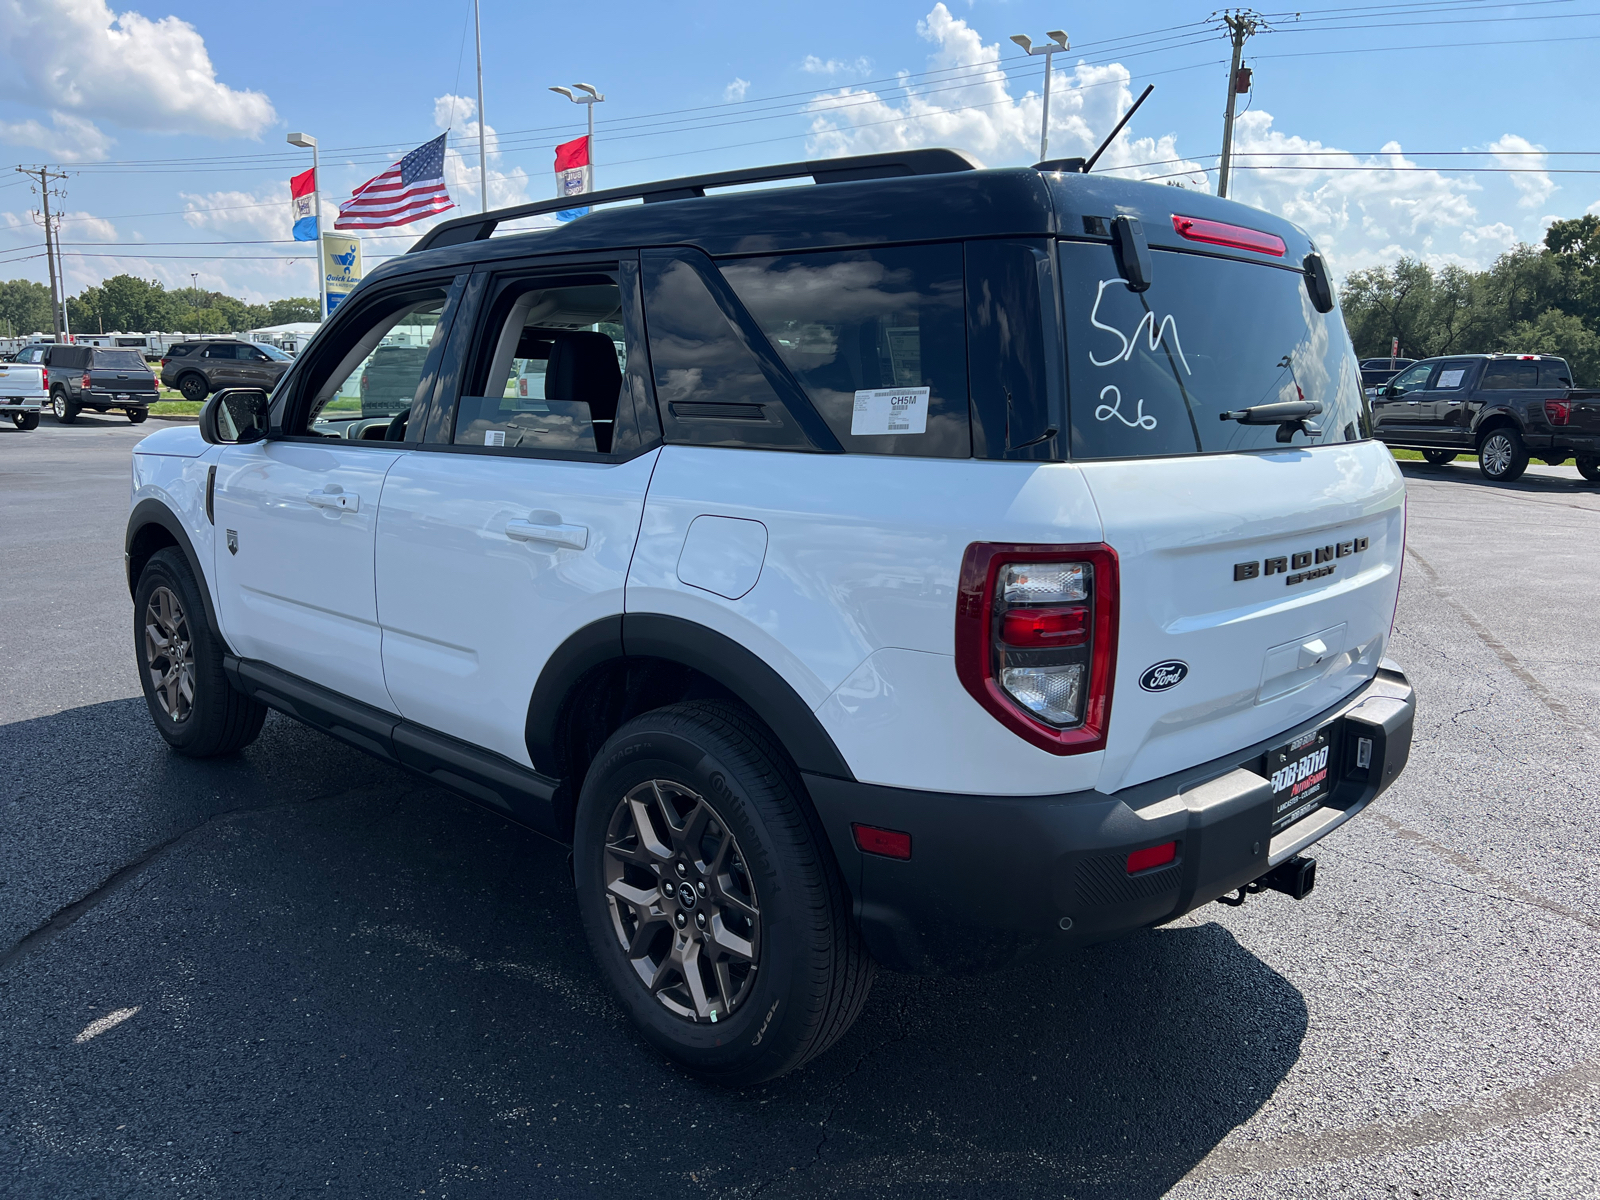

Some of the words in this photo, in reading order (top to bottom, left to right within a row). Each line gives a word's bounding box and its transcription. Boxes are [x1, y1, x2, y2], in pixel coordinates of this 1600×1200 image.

[326, 274, 346, 282] Quick
[890, 395, 917, 406] CH5M
[1095, 385, 1158, 430] 26
[1233, 536, 1369, 582] BRONCO
[1286, 564, 1337, 586] SPORT
[1149, 665, 1183, 688] Ford
[708, 770, 777, 878] Continental
